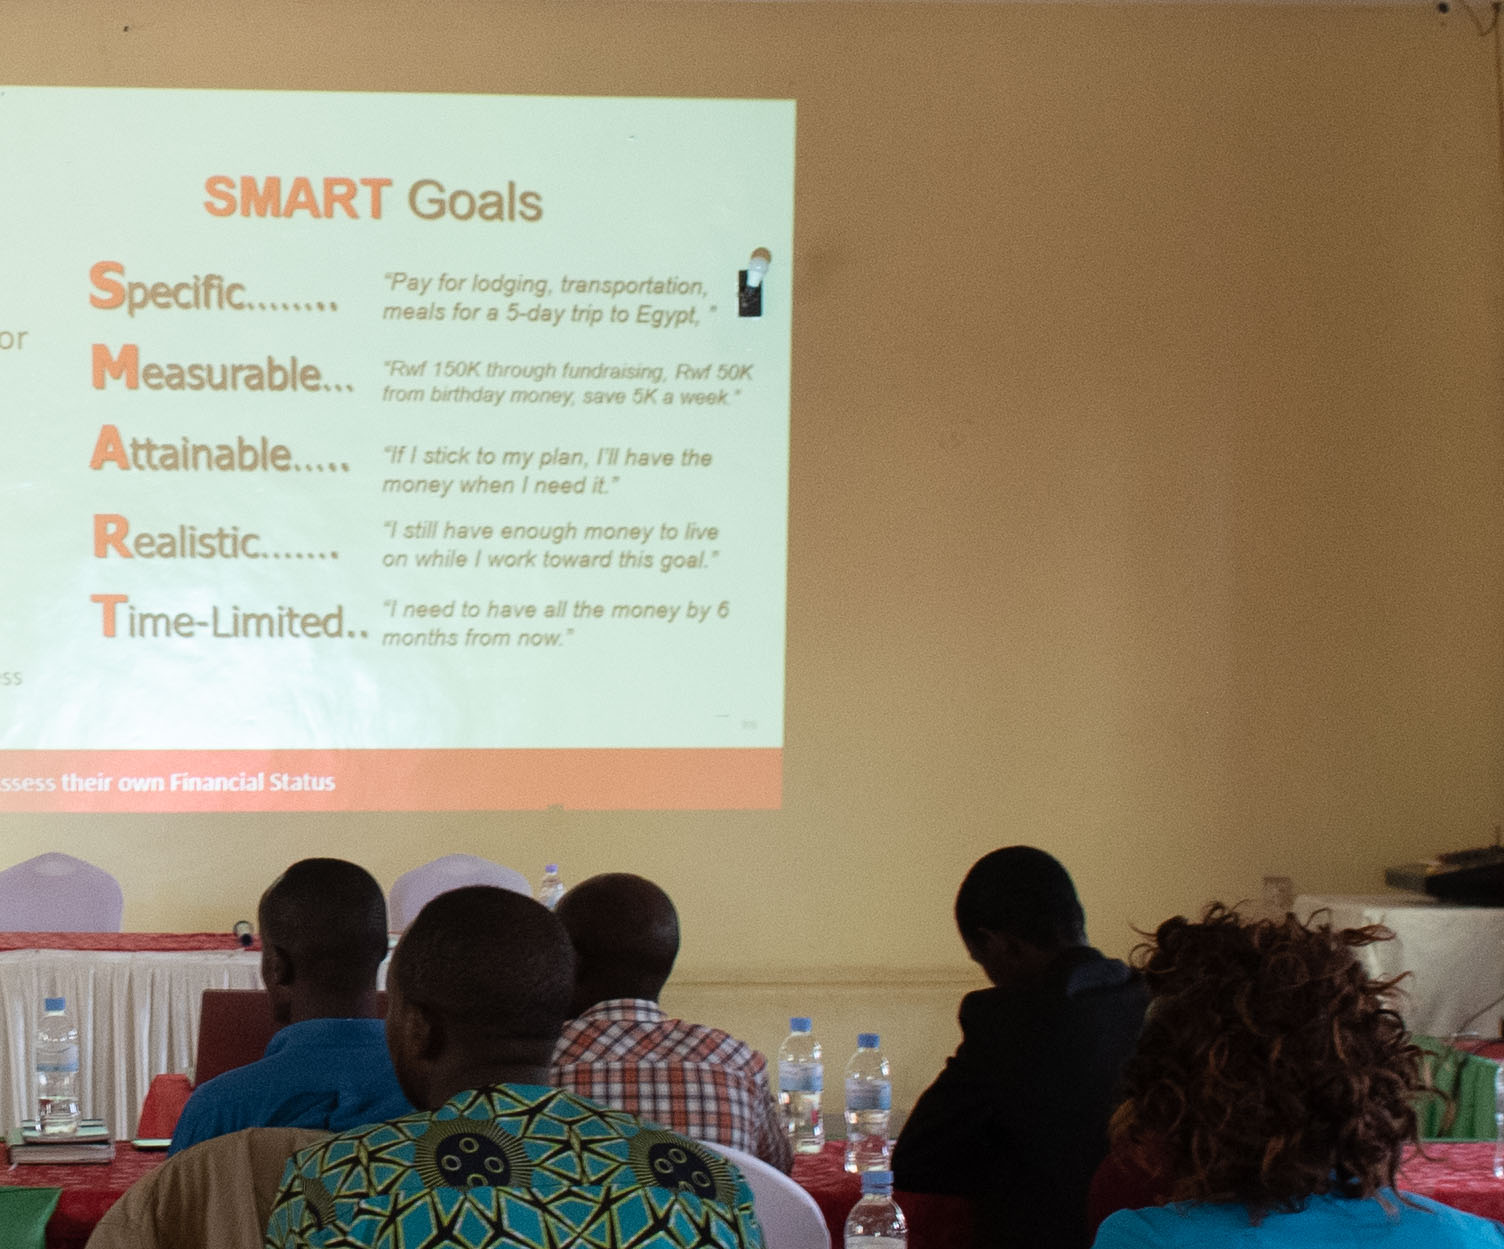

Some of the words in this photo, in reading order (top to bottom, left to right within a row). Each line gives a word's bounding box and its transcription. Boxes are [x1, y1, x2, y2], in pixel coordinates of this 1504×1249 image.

[203, 175, 394, 221] SMART
[407, 178, 544, 223] Goals
[437, 272, 468, 293] for
[471, 273, 552, 299] lodging,
[560, 275, 708, 299] transportation,
[382, 301, 446, 322] meals
[451, 301, 482, 322] for
[485, 306, 500, 322] a
[506, 302, 567, 328] 5-day
[570, 304, 604, 328] trip
[609, 304, 630, 325] to
[434, 359, 482, 378] 150K
[485, 361, 558, 383] through
[561, 361, 667, 385] fundraising,
[674, 362, 713, 381] Rwf
[716, 363, 754, 382] 50K
[381, 384, 426, 403] from
[429, 385, 507, 407] birthday
[509, 389, 575, 408] money,
[582, 390, 627, 405] save
[632, 386, 660, 406] 5K
[661, 391, 675, 406] a
[409, 445, 418, 465] I
[422, 446, 471, 466] stick
[475, 446, 497, 466] to
[501, 450, 535, 471] my
[538, 447, 589, 470] plan,
[624, 448, 675, 467] have
[680, 448, 714, 468] the
[382, 478, 455, 499] money
[459, 475, 515, 495] when
[520, 474, 530, 495] I
[534, 476, 588, 495] need
[402, 520, 439, 540] still
[443, 521, 494, 540] have
[499, 521, 578, 546] enough
[583, 525, 655, 545] money
[659, 522, 680, 541] to
[684, 522, 720, 542] live
[381, 552, 409, 568] on
[415, 549, 469, 569] while
[473, 548, 483, 569] I
[487, 549, 537, 569] work
[542, 550, 614, 569] toward
[618, 550, 655, 569] this
[403, 600, 456, 619] need
[460, 600, 482, 619] to
[486, 600, 538, 619] have
[543, 600, 569, 619] all
[572, 600, 605, 619] the
[611, 604, 681, 624] money
[685, 600, 712, 624] by
[716, 599, 730, 620] 6
[381, 627, 459, 648] months
[464, 627, 512, 648] from
[61, 771, 114, 793] their
[117, 776, 166, 792] own
[169, 771, 265, 792] Financial
[269, 772, 336, 792] Status
